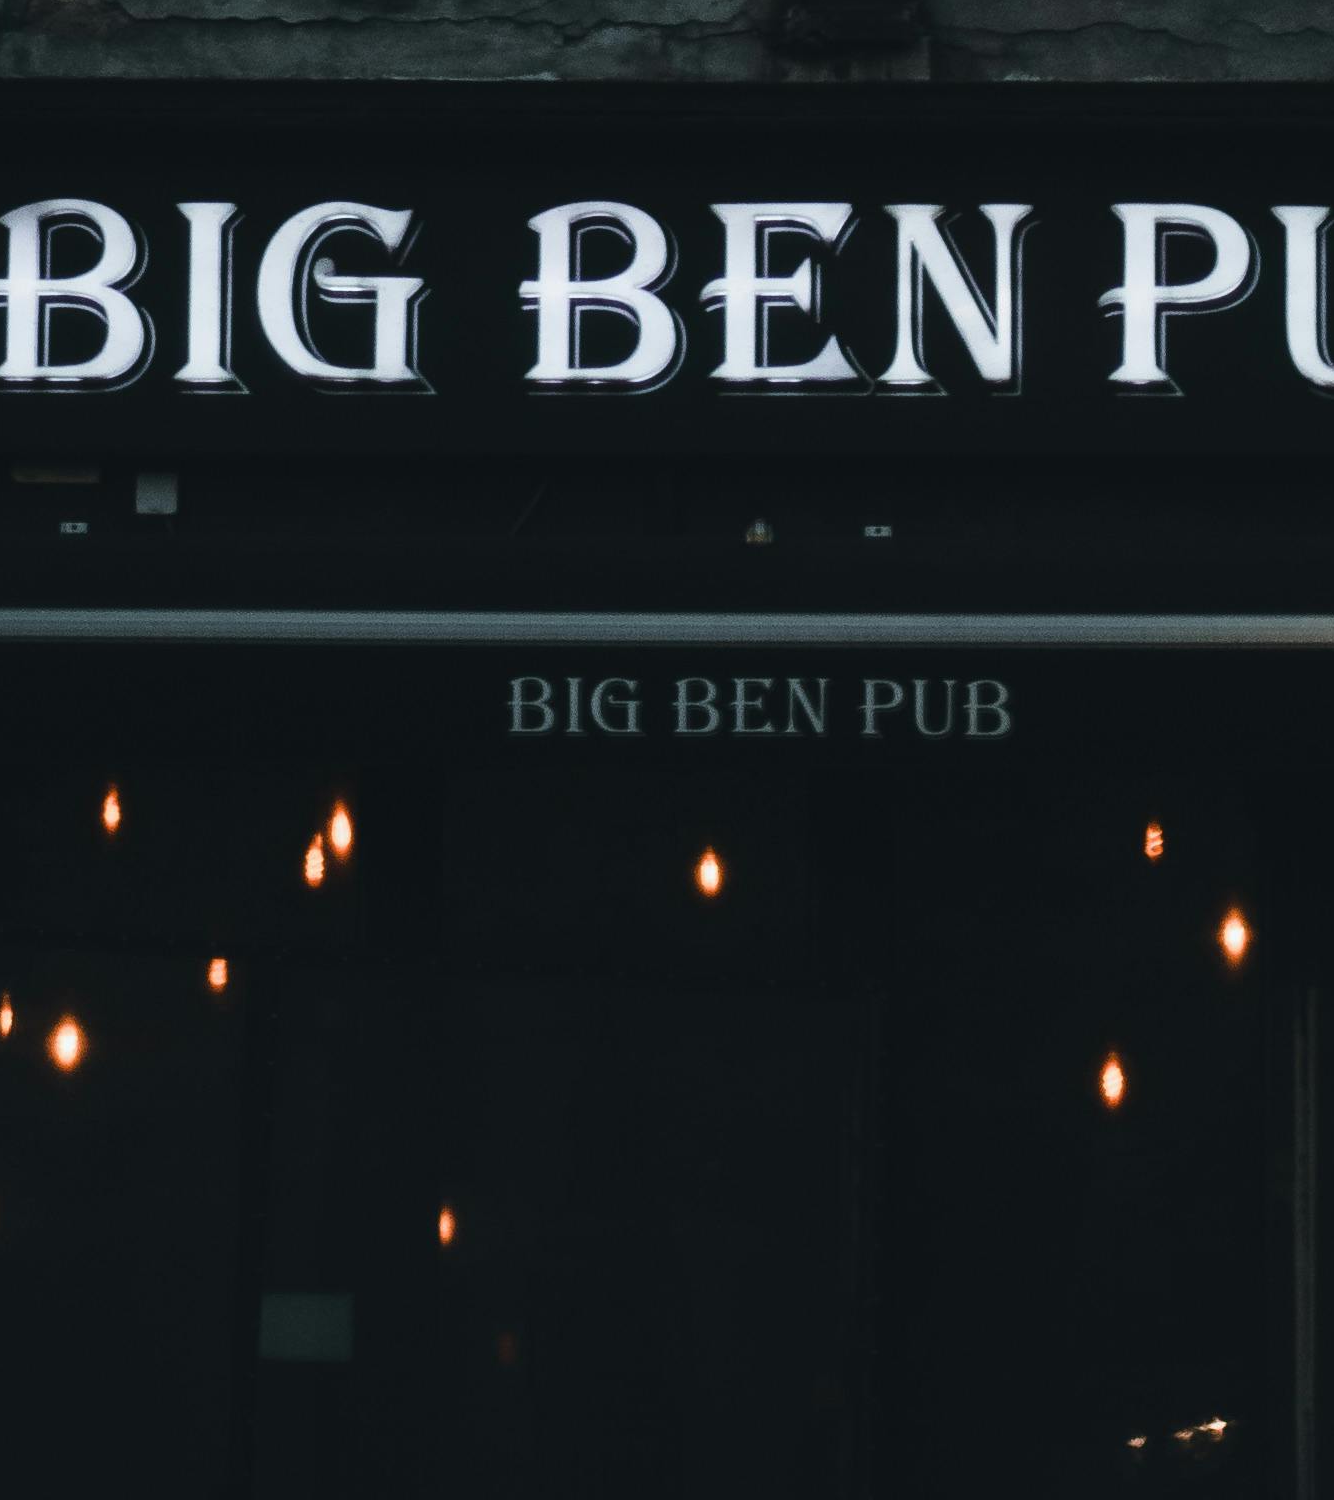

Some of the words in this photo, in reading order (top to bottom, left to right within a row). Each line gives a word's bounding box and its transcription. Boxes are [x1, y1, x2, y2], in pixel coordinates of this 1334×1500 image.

[517, 200, 1040, 396] BEN
[507, 676, 647, 737] BIG
[672, 677, 832, 737] BEN
[858, 678, 1014, 739] PUB
